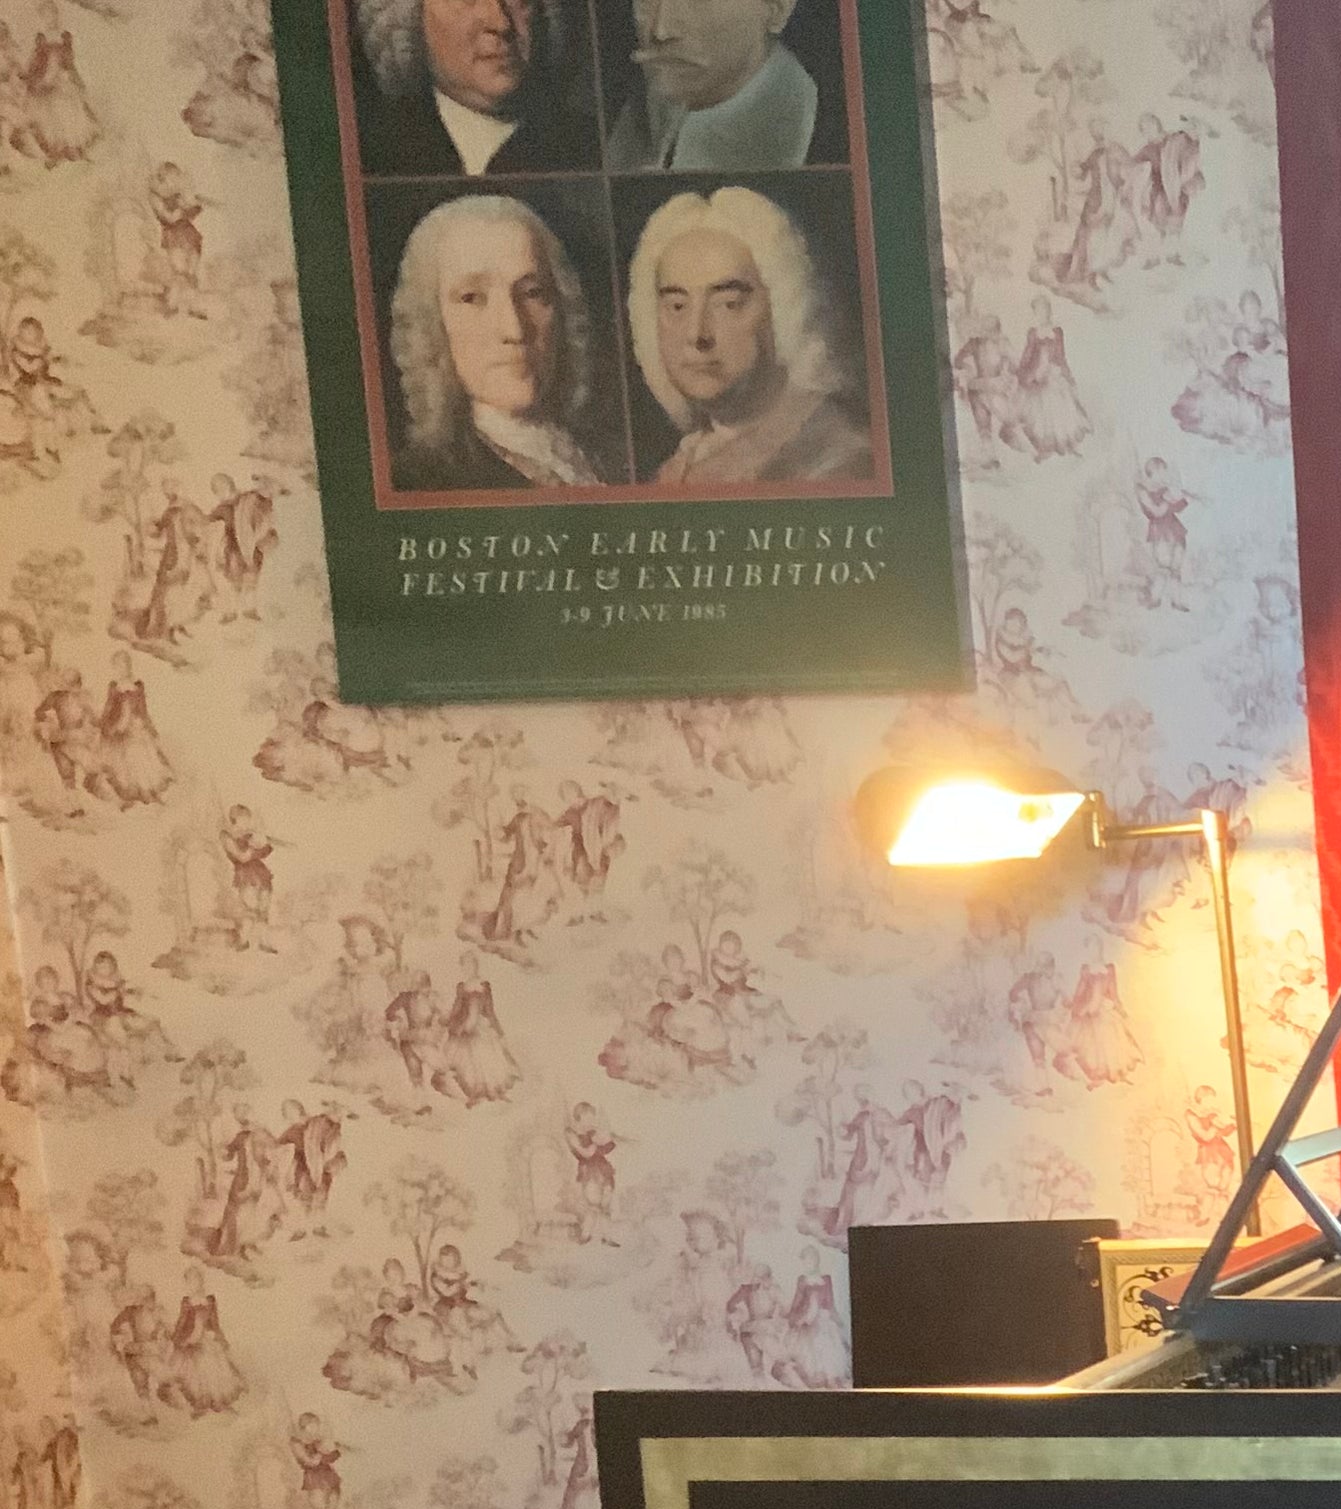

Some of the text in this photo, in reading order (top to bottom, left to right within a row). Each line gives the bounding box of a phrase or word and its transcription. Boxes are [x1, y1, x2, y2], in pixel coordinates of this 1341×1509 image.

[399, 525, 883, 561] BOSTON EARLY MUSIC
[401, 561, 885, 595] FESTIVAL & EXHIBITION
[601, 603, 671, 629] JUNE
